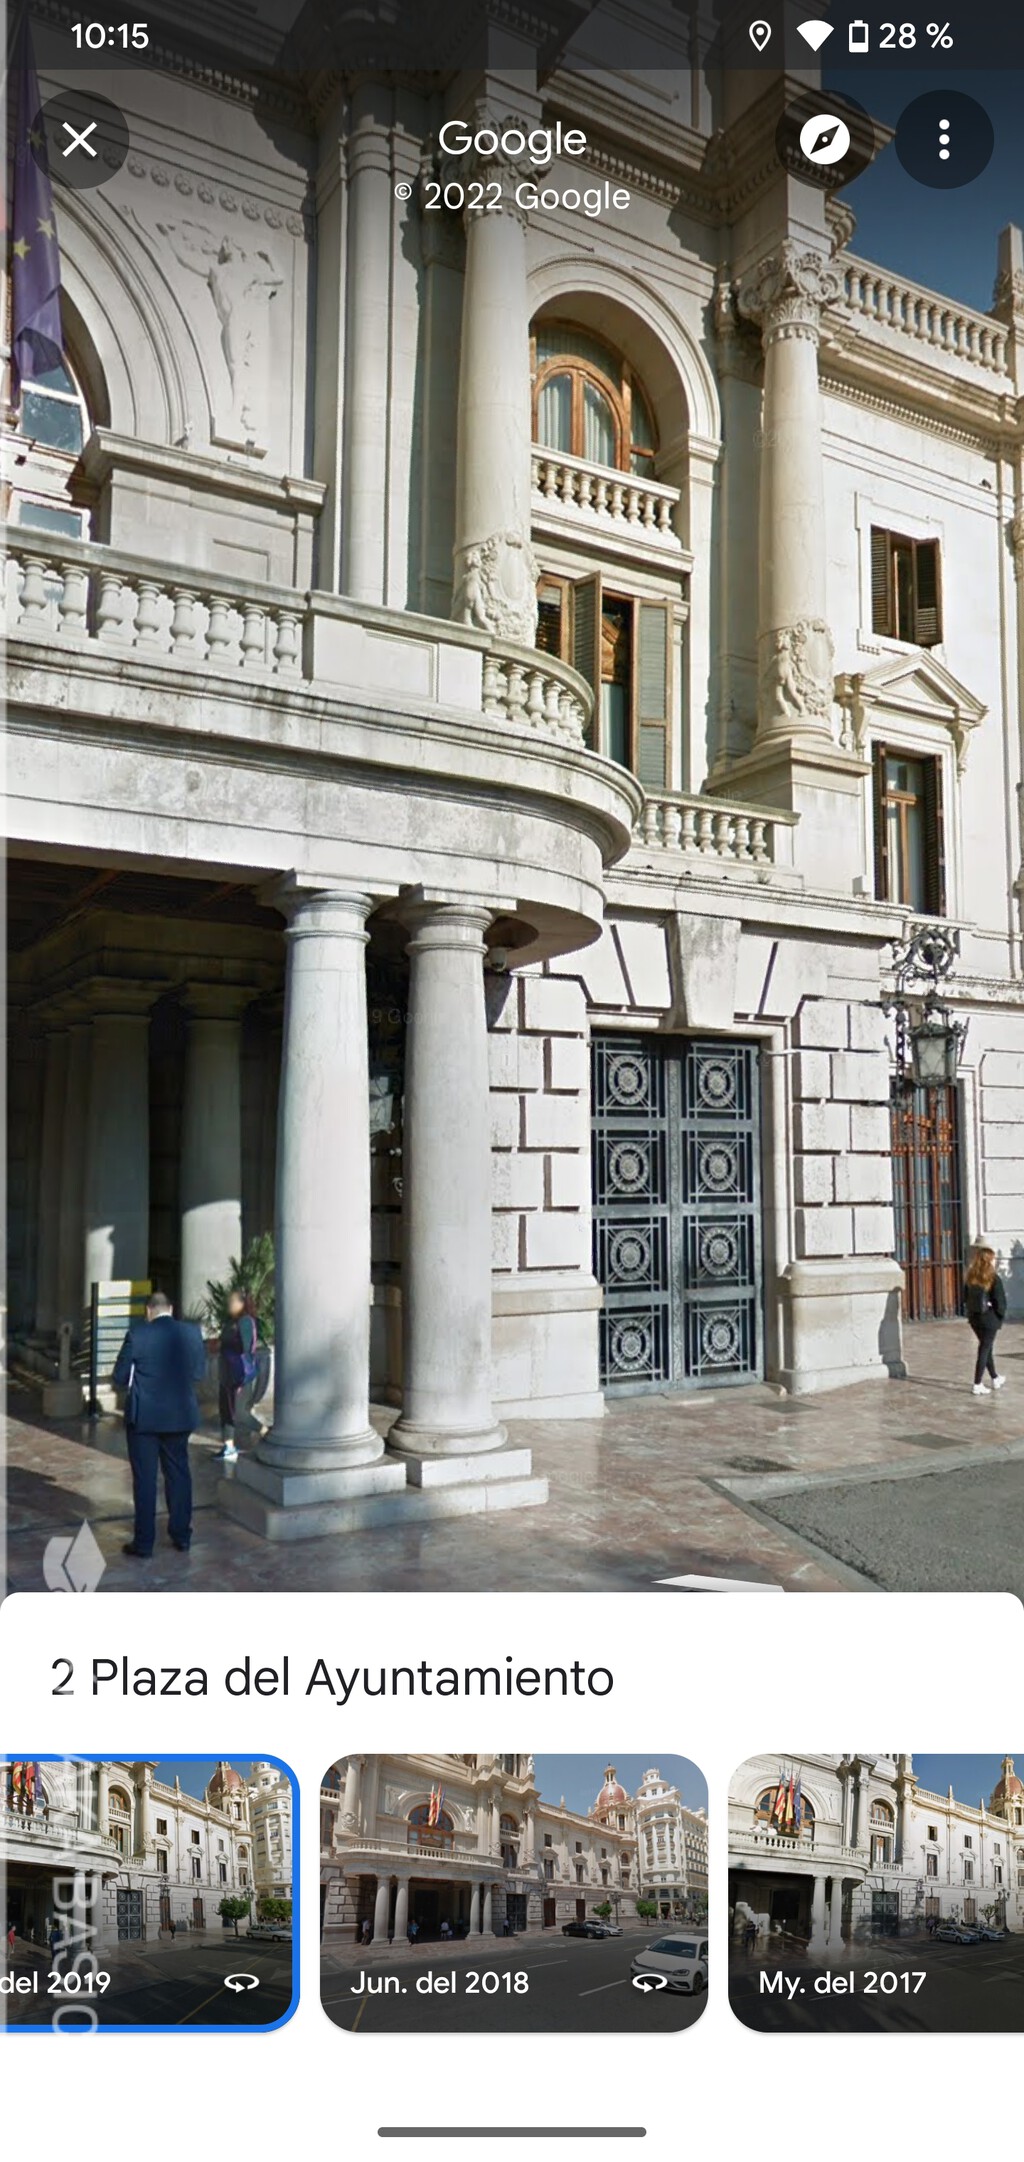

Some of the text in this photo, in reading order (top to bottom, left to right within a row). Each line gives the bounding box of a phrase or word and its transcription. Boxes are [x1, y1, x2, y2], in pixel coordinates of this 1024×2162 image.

[71, 22, 149, 49] 10:15
[879, 22, 954, 49] 28 %
[51, 1655, 614, 1707] 2 Plaza del Ayuntamiento
[0, 1971, 111, 1994] del 2019
[350, 1970, 529, 1994] Jun. del 2018
[759, 1970, 927, 2000] My. del 2017
